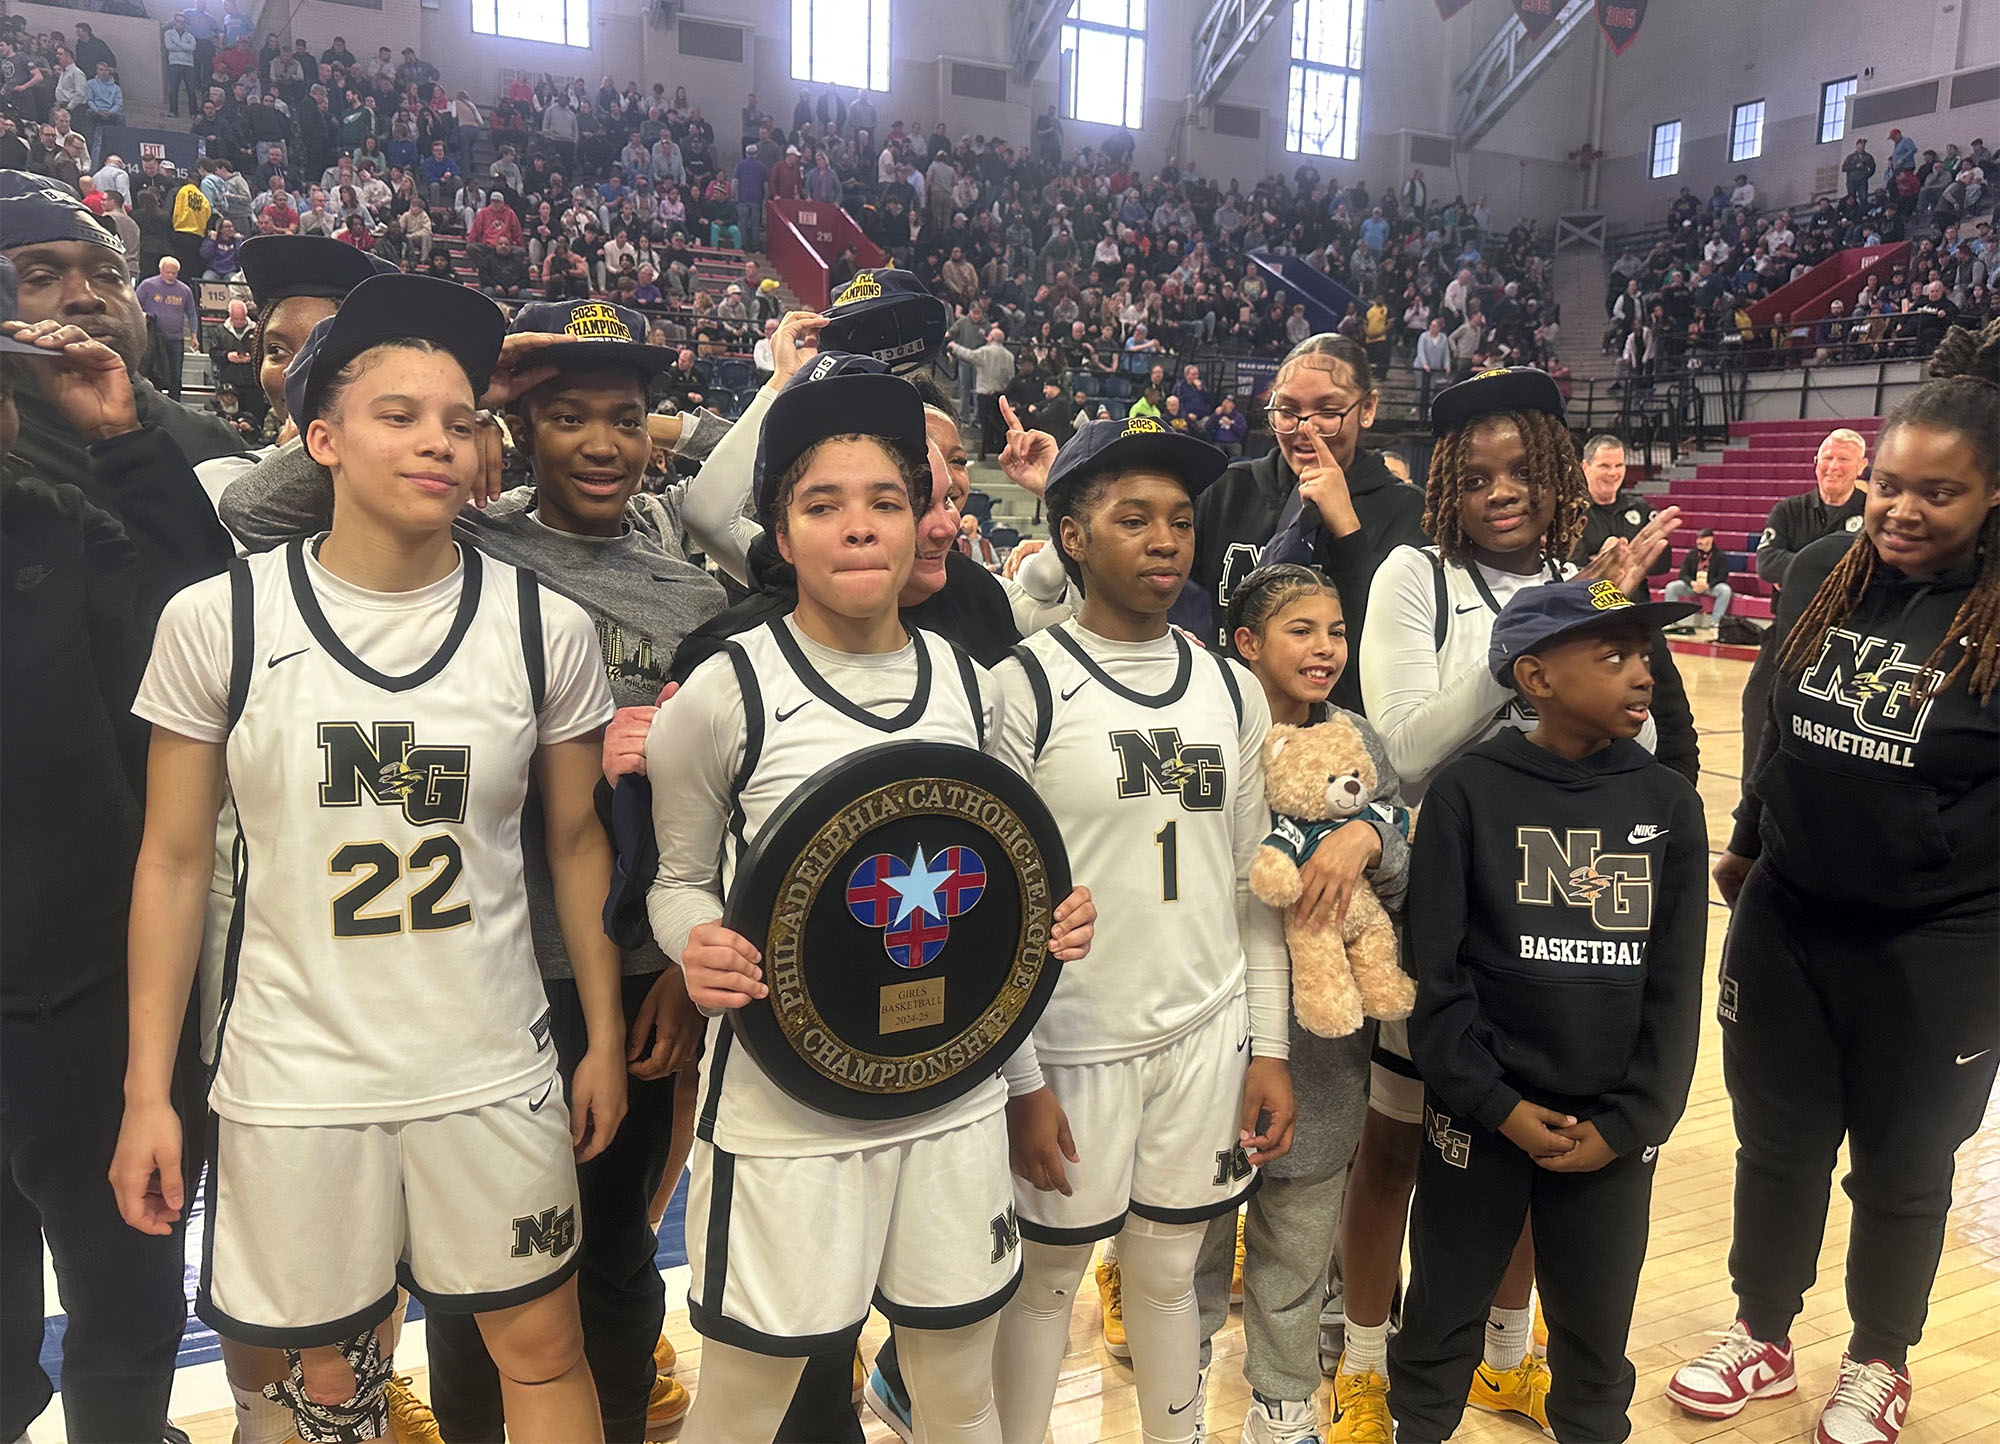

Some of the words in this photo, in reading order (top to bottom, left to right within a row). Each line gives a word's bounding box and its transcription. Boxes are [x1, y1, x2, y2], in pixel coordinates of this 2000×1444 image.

[143, 145, 161, 158] EXIT
[208, 291, 226, 301] 115
[572, 306, 597, 320] 2025
[840, 284, 880, 301] AMPIONS
[566, 320, 631, 339] CHAMPIONS
[1130, 420, 1153, 430] 2025
[1799, 626, 1945, 744] NG
[1793, 714, 1914, 767] BASKETBALL
[317, 721, 470, 827] NG
[1109, 727, 1226, 811] NG
[1633, 824, 1658, 837] NIKE
[328, 832, 473, 939] 22
[1154, 819, 1179, 903] 1
[1516, 825, 1653, 932] NG
[774, 794, 900, 1014] PHILADELPHIA
[908, 784, 1033, 860] CATHOLIC
[1013, 859, 1047, 990] LEAGUE
[1520, 935, 1646, 966] BASKETBAL
[881, 997, 942, 1014] BASKETBALL
[896, 1012, 928, 1025] 2024-25
[898, 987, 927, 1000] GIRLS
[803, 1007, 1006, 1087] CHAMPIONSHIP
[1425, 1105, 1471, 1168] NG
[511, 1204, 575, 1258] NG
[990, 1200, 1019, 1264] N
